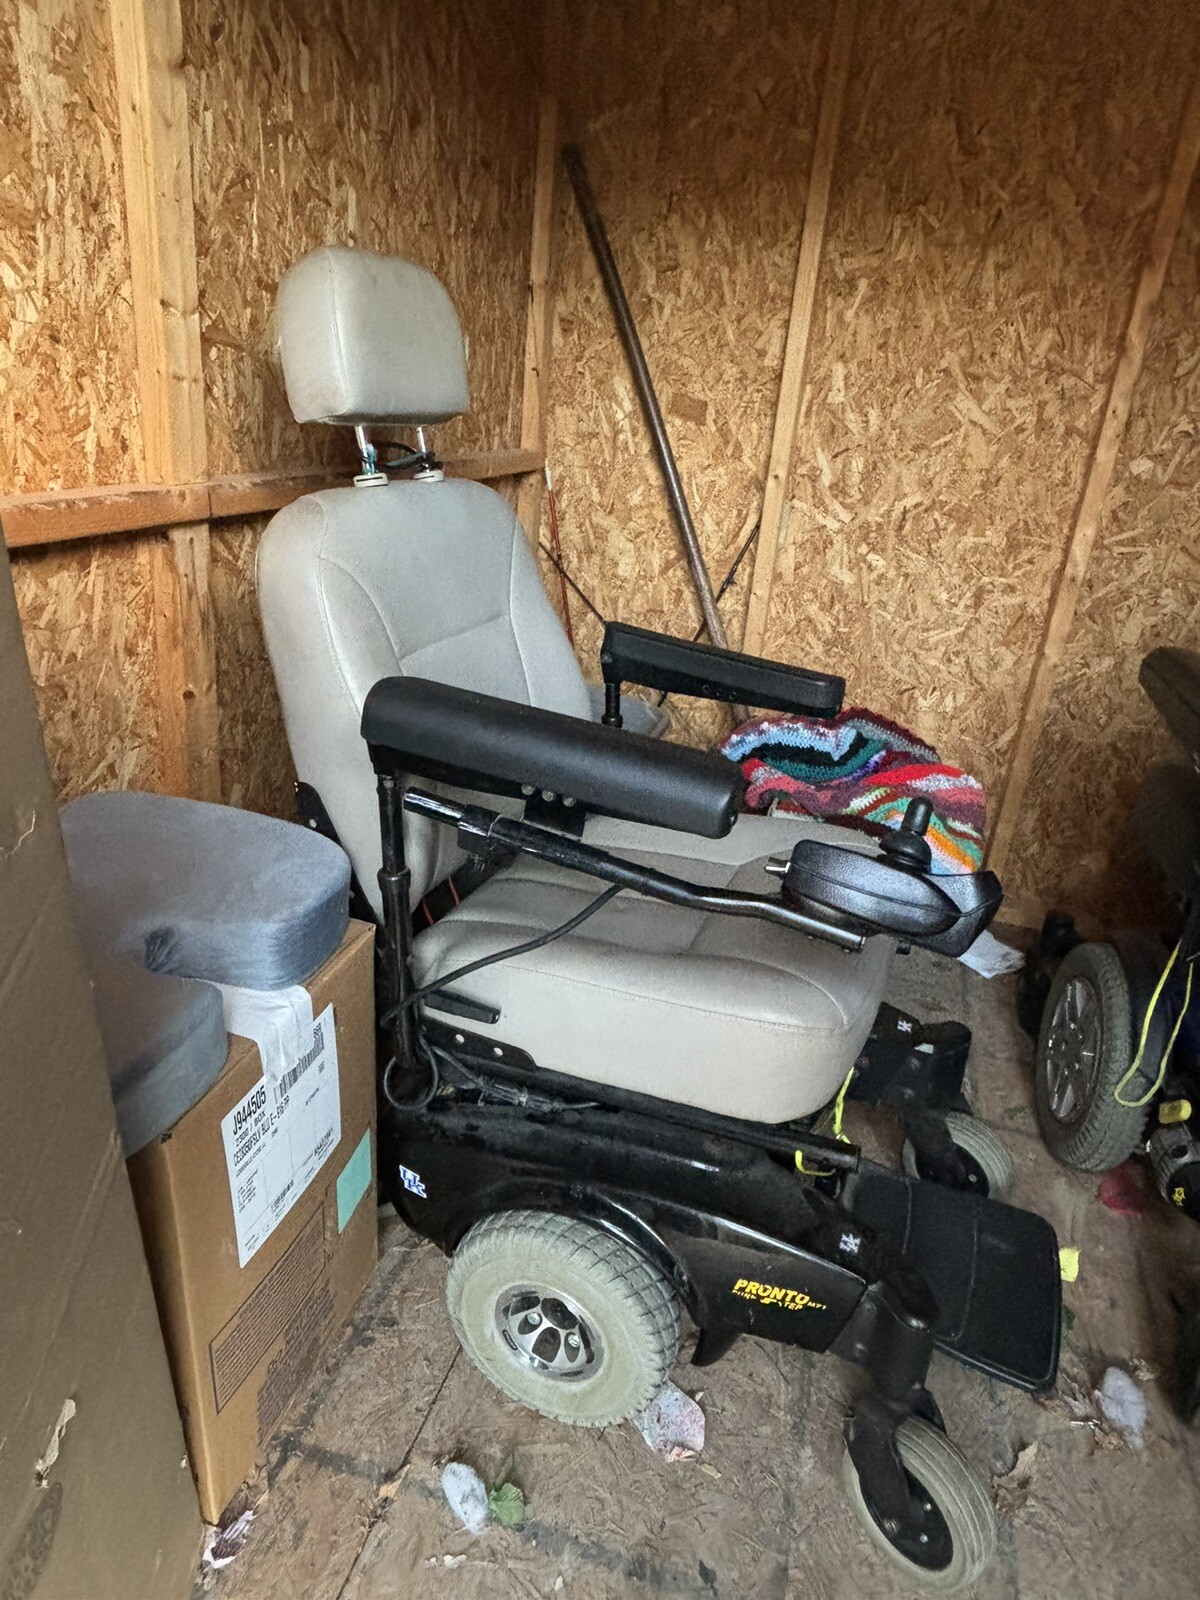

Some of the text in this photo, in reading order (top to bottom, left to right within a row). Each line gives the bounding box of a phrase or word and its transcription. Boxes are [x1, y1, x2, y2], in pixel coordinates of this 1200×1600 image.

[233, 1084, 266, 1135] J944505
[399, 1165, 426, 1198] UK
[734, 1278, 810, 1304] PRONTO
